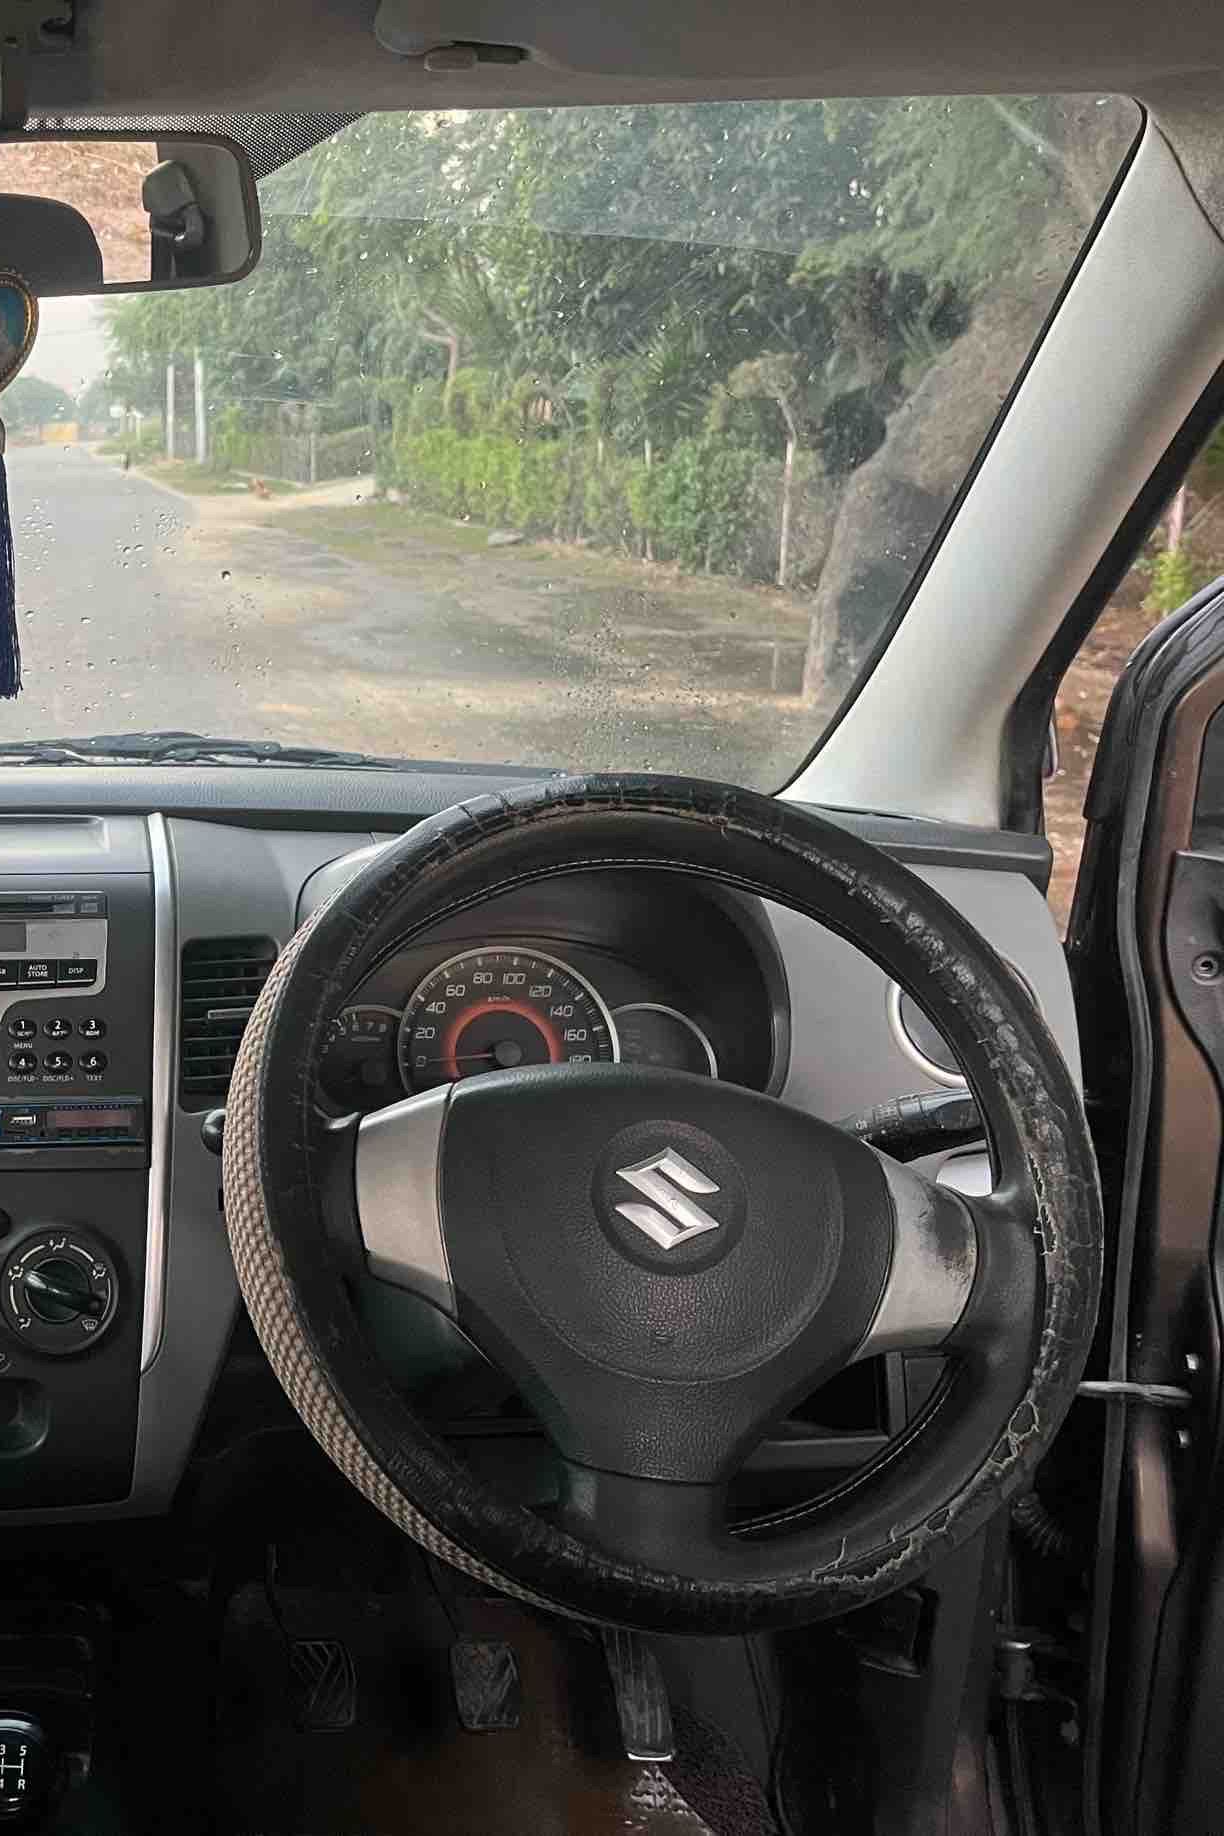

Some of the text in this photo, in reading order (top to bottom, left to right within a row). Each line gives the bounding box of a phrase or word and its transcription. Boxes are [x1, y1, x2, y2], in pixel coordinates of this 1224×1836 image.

[68, 967, 84, 975] DISP
[472, 971, 494, 985] 80
[501, 972, 526, 985] 100
[445, 984, 467, 997] 60
[528, 984, 553, 998] 120
[425, 1000, 447, 1014] 40
[549, 1004, 574, 1017] 140
[54, 1020, 61, 1030] 2
[89, 1020, 96, 1030] 3
[415, 1026, 436, 1040] 20
[563, 1028, 587, 1042] 160
[18, 1058, 26, 1067] 4
[55, 1057, 62, 1066] 5
[89, 1057, 97, 1066] 6
[19, 1745, 28, 1757] 5
[17, 1779, 26, 1791] R
